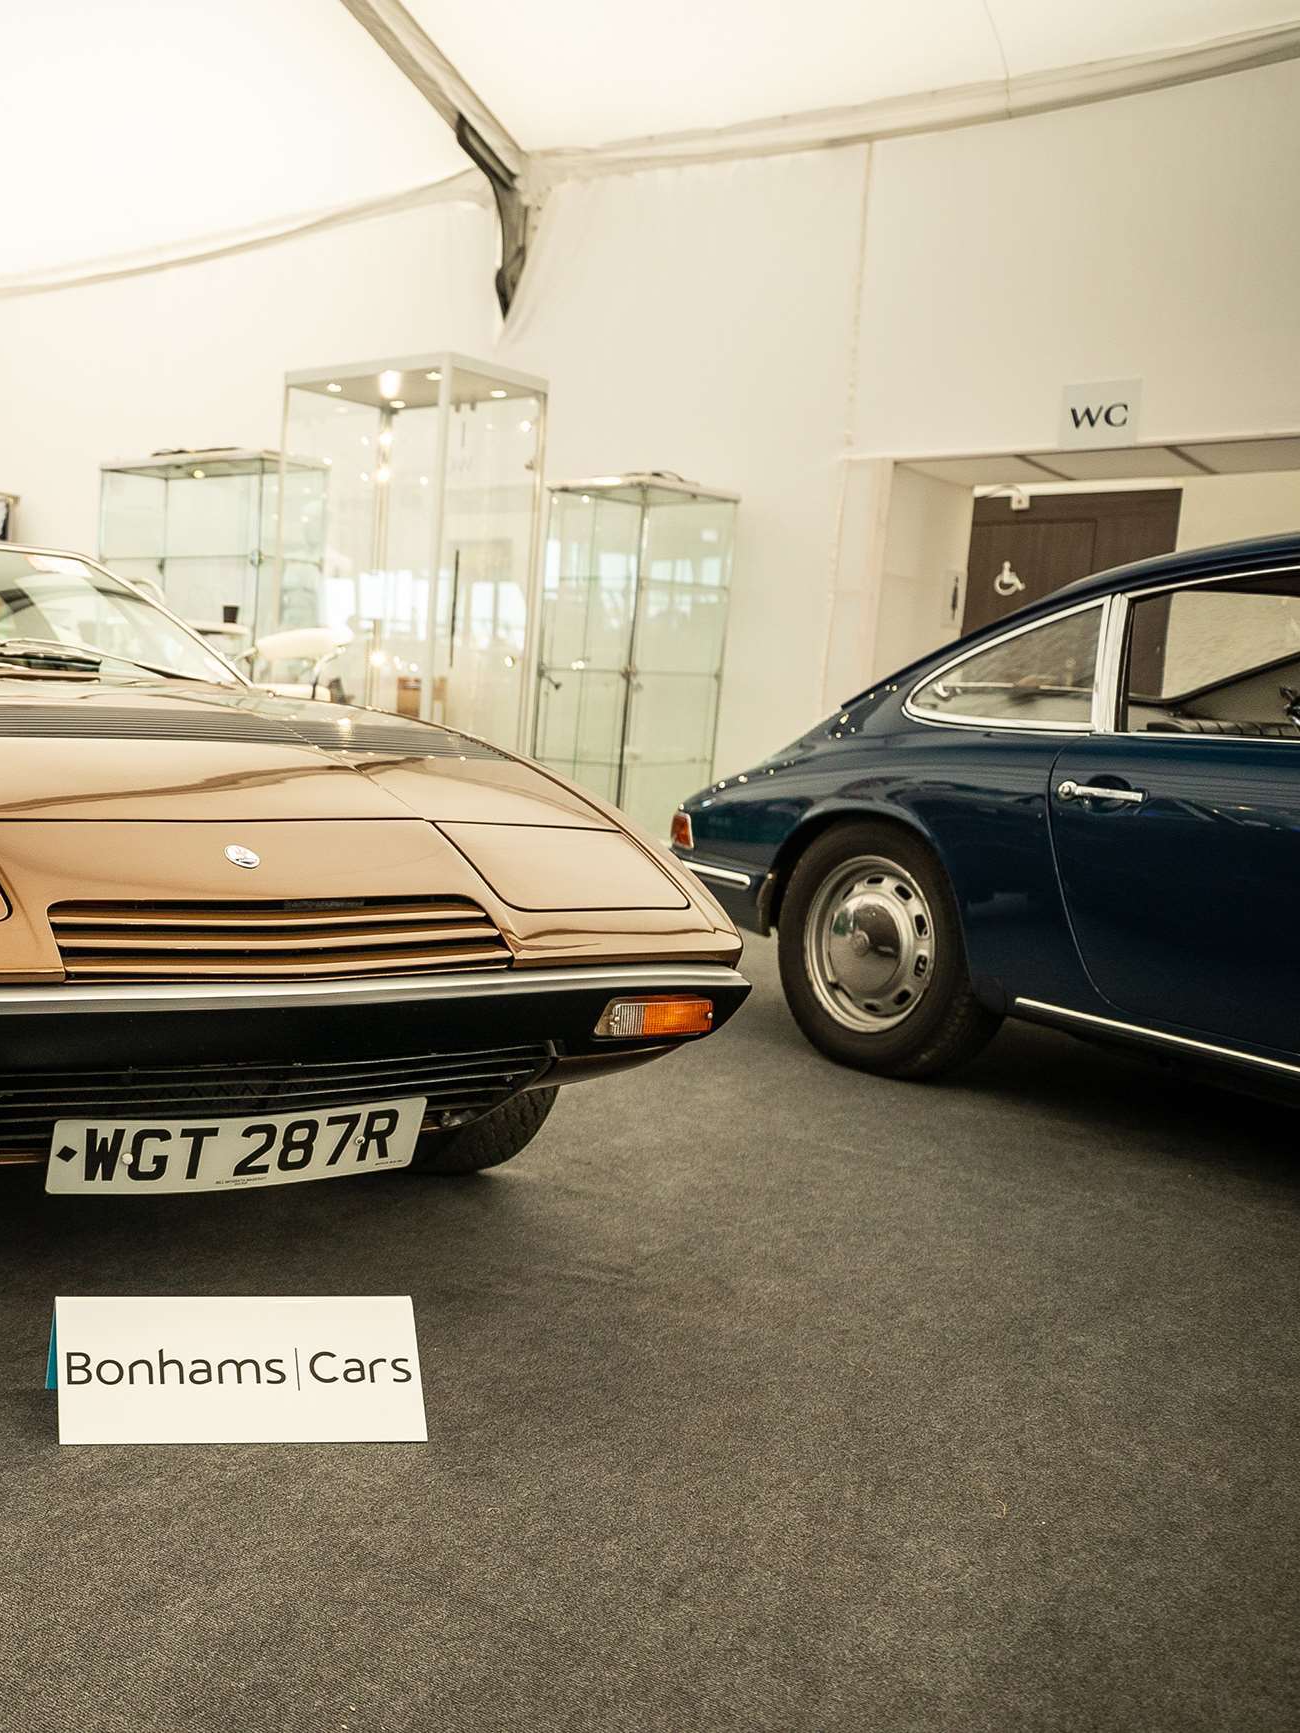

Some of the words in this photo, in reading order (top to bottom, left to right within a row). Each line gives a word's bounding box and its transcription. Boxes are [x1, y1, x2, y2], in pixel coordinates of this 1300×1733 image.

[1070, 403, 1128, 429] WC
[83, 1127, 220, 1182] WGT
[232, 1108, 400, 1177] 287R
[66, 1348, 287, 1385] Bonhams
[309, 1351, 413, 1384] Cars
